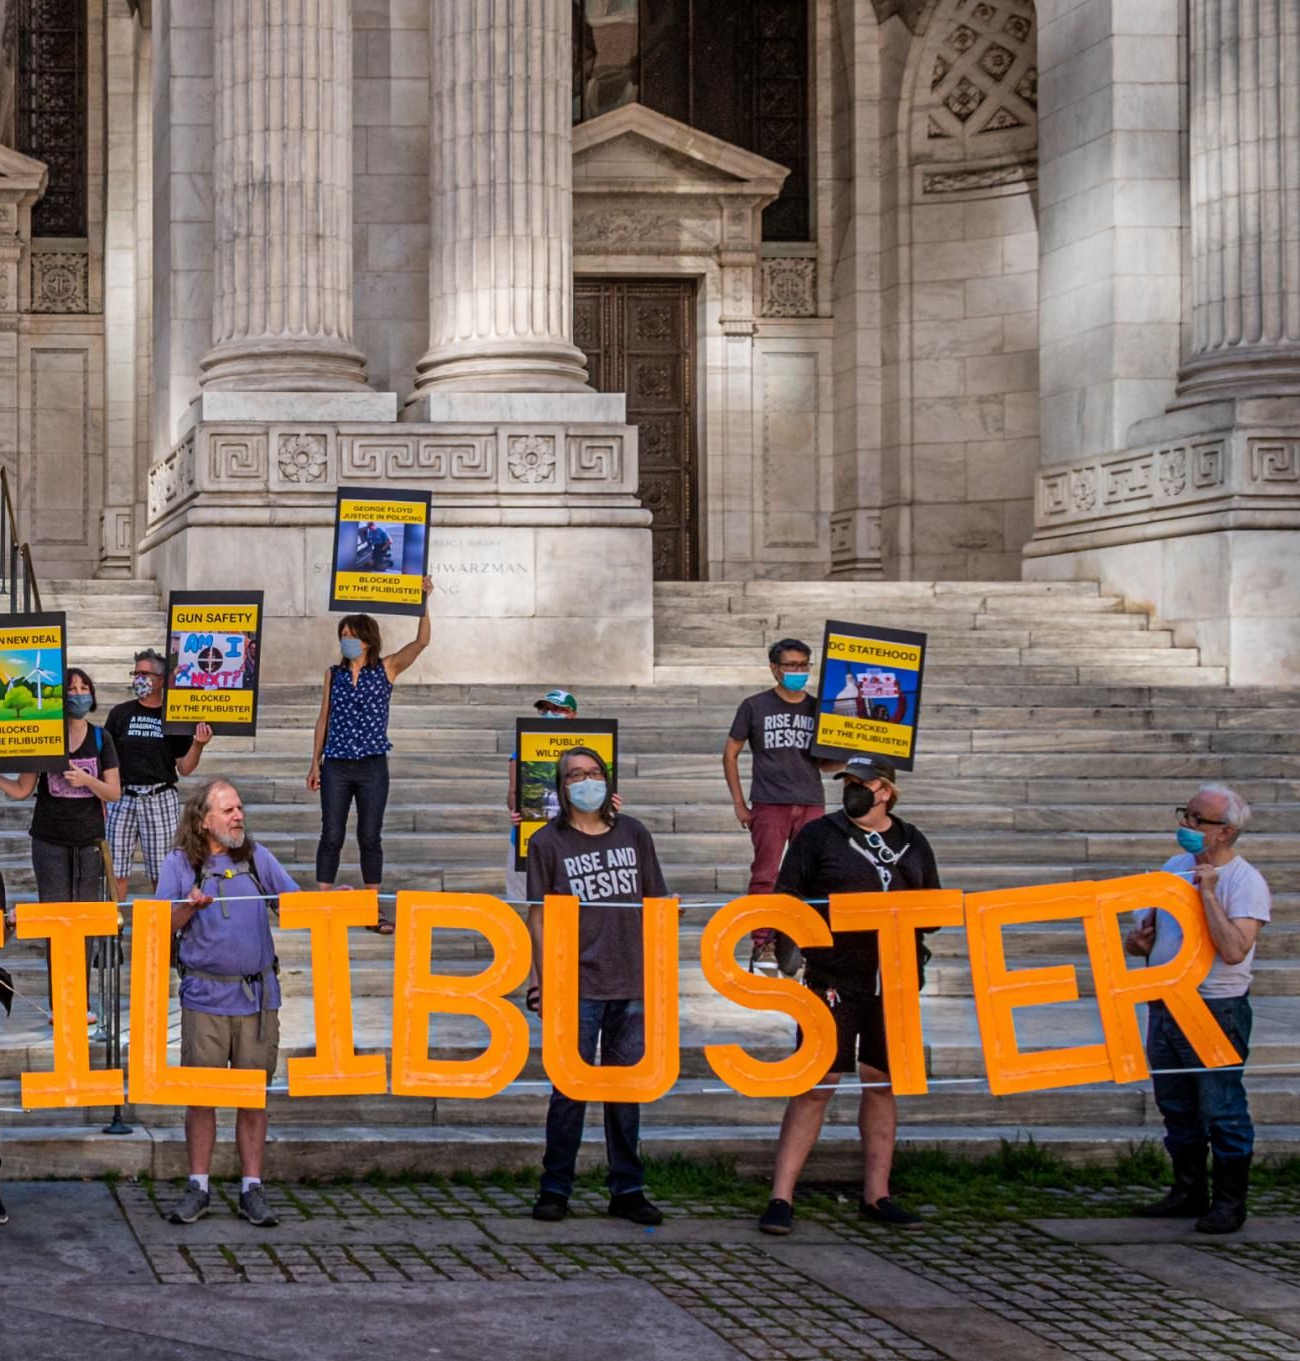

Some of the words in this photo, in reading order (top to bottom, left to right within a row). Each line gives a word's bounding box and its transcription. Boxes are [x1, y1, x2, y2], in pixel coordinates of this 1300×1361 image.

[353, 505, 385, 513] GEORGE
[386, 514, 423, 522] POLICING
[429, 562, 528, 574] HWARZMAN
[358, 576, 401, 585] BLOCKED
[351, 585, 369, 593] THE
[370, 586, 421, 595] FILIBUSTER
[177, 613, 203, 623] GUN
[205, 613, 253, 623] SAFETY
[6, 636, 30, 645] NEW
[31, 635, 58, 644] DEAL
[184, 633, 214, 654] AM
[224, 636, 243, 658] I
[828, 641, 845, 651] DC
[848, 645, 918, 662] STATEHOOD
[191, 670, 242, 687] NEXT?
[190, 694, 231, 703] BLOCKED
[201, 705, 251, 713] FILIBUSTER
[137, 716, 162, 726] RADICA
[764, 713, 791, 731] RISE
[793, 714, 815, 731] AND
[844, 721, 889, 734] BLOCKED
[8, 736, 62, 746] FILIBUSTER
[549, 738, 585, 746] PUBLIC
[764, 728, 813, 750] RESIST
[821, 727, 835, 735] BY
[837, 730, 854, 739] THE
[856, 732, 909, 747] FILIBUSTER
[564, 852, 604, 877] RISE
[607, 847, 637, 868] AND
[569, 868, 638, 901] RESIST
